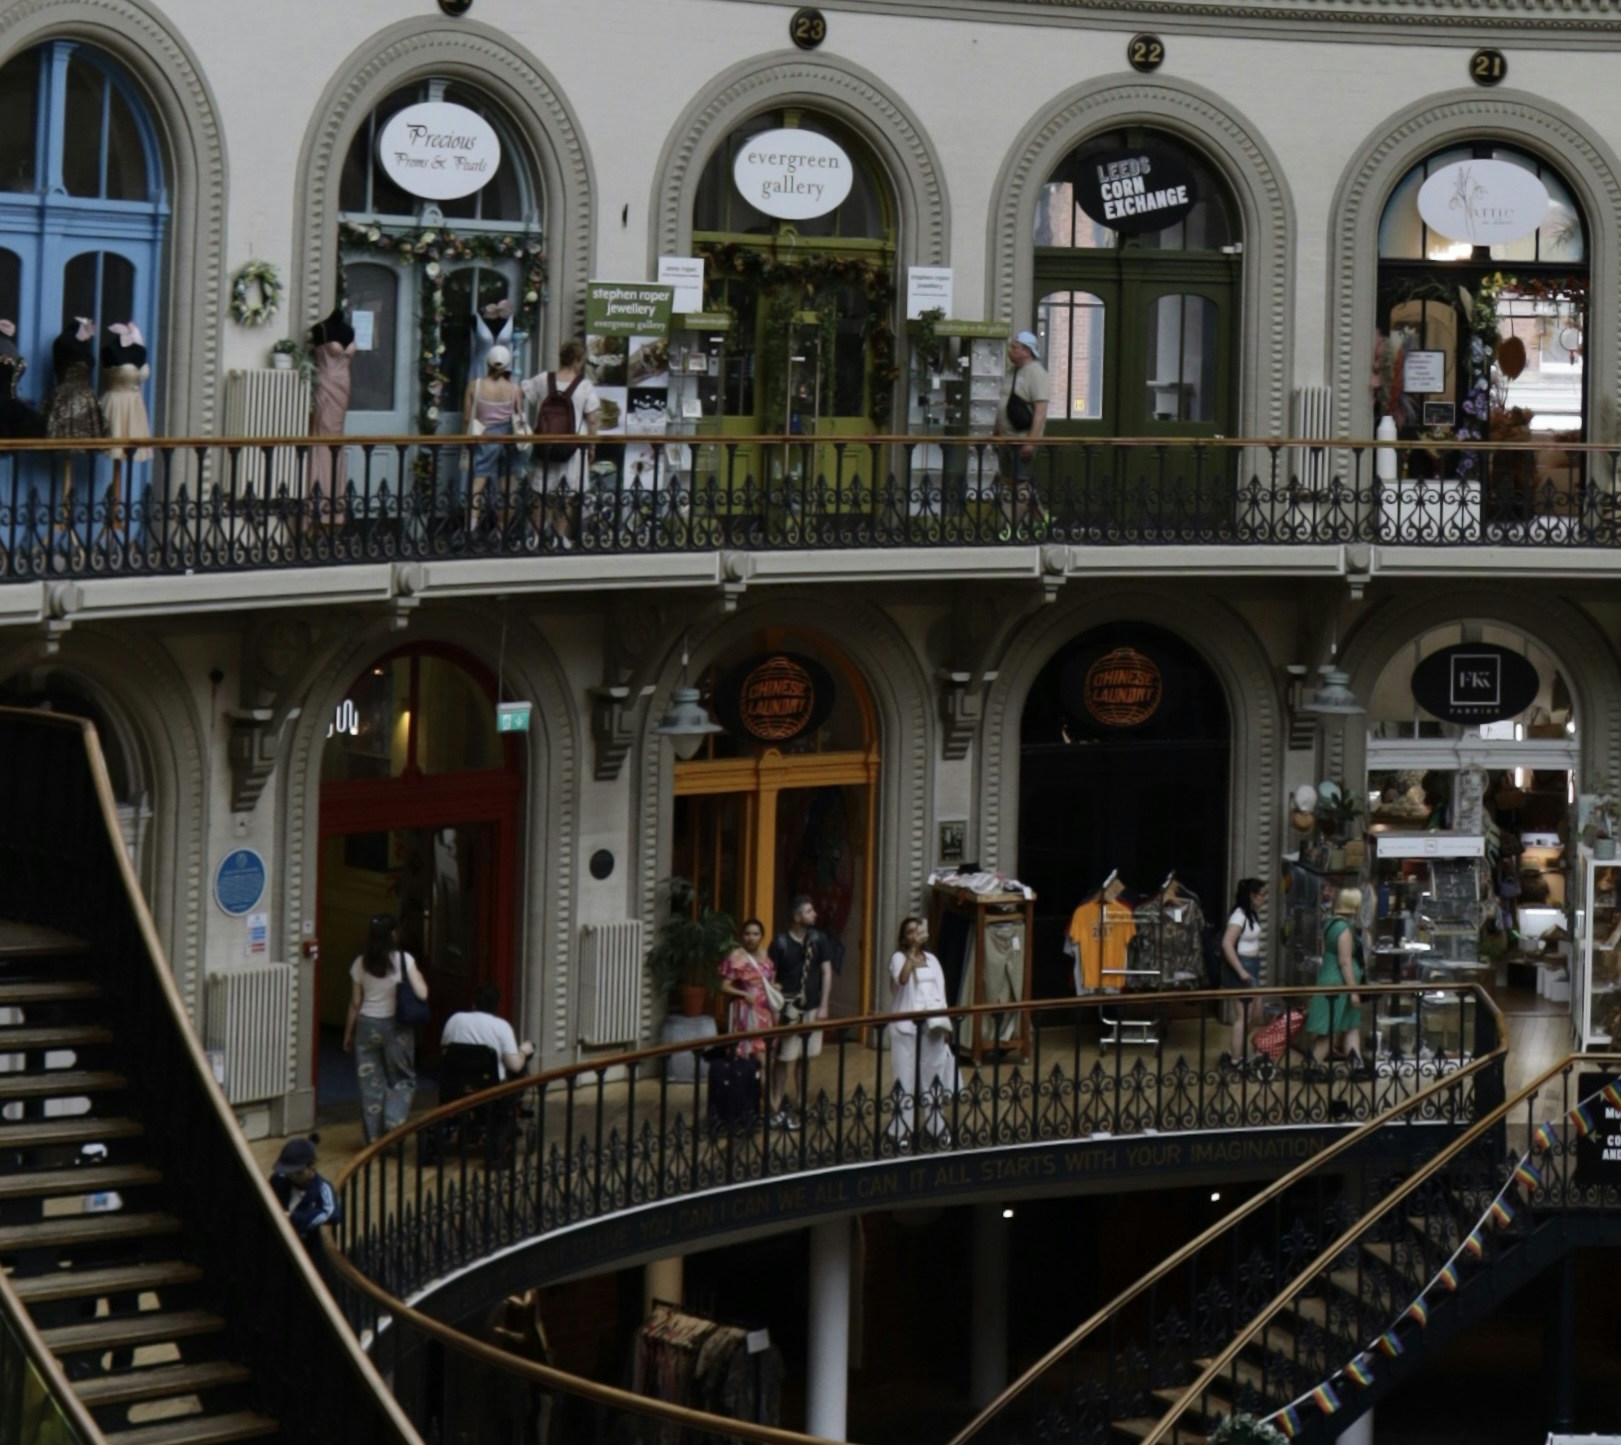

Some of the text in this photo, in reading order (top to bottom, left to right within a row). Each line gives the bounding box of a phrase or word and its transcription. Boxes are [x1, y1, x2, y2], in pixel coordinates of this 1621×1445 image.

[796, 17, 825, 40] 23
[1134, 42, 1162, 63] 22
[1475, 56, 1501, 77] 21
[406, 123, 478, 150] Precious
[431, 154, 447, 170] &
[453, 155, 488, 172] Pearls
[747, 151, 840, 172] evergreen
[1097, 156, 1152, 183] LEEDS
[761, 175, 825, 202] gallery
[1101, 176, 1145, 201] CORN
[1104, 185, 1189, 220] EXCHANGE
[592, 287, 671, 304] stephen roper
[606, 301, 656, 318] jewellery
[1092, 668, 1154, 687] CHINESE
[1092, 687, 1154, 705] LAUNDRY
[639, 1216, 672, 1240] YOU
[679, 1206, 714, 1230] CAN
[732, 1193, 771, 1218] CAN
[779, 1186, 808, 1210] WE
[814, 1179, 847, 1205] ALL
[859, 1173, 897, 1198] CAN
[908, 1169, 926, 1191] IT
[934, 1163, 972, 1187] ALL
[982, 1155, 1057, 1183] STARTS
[1064, 1147, 1118, 1173] WITH
[1126, 1142, 1182, 1167] YOUR
[1190, 1135, 1326, 1162] IMAGINATION
